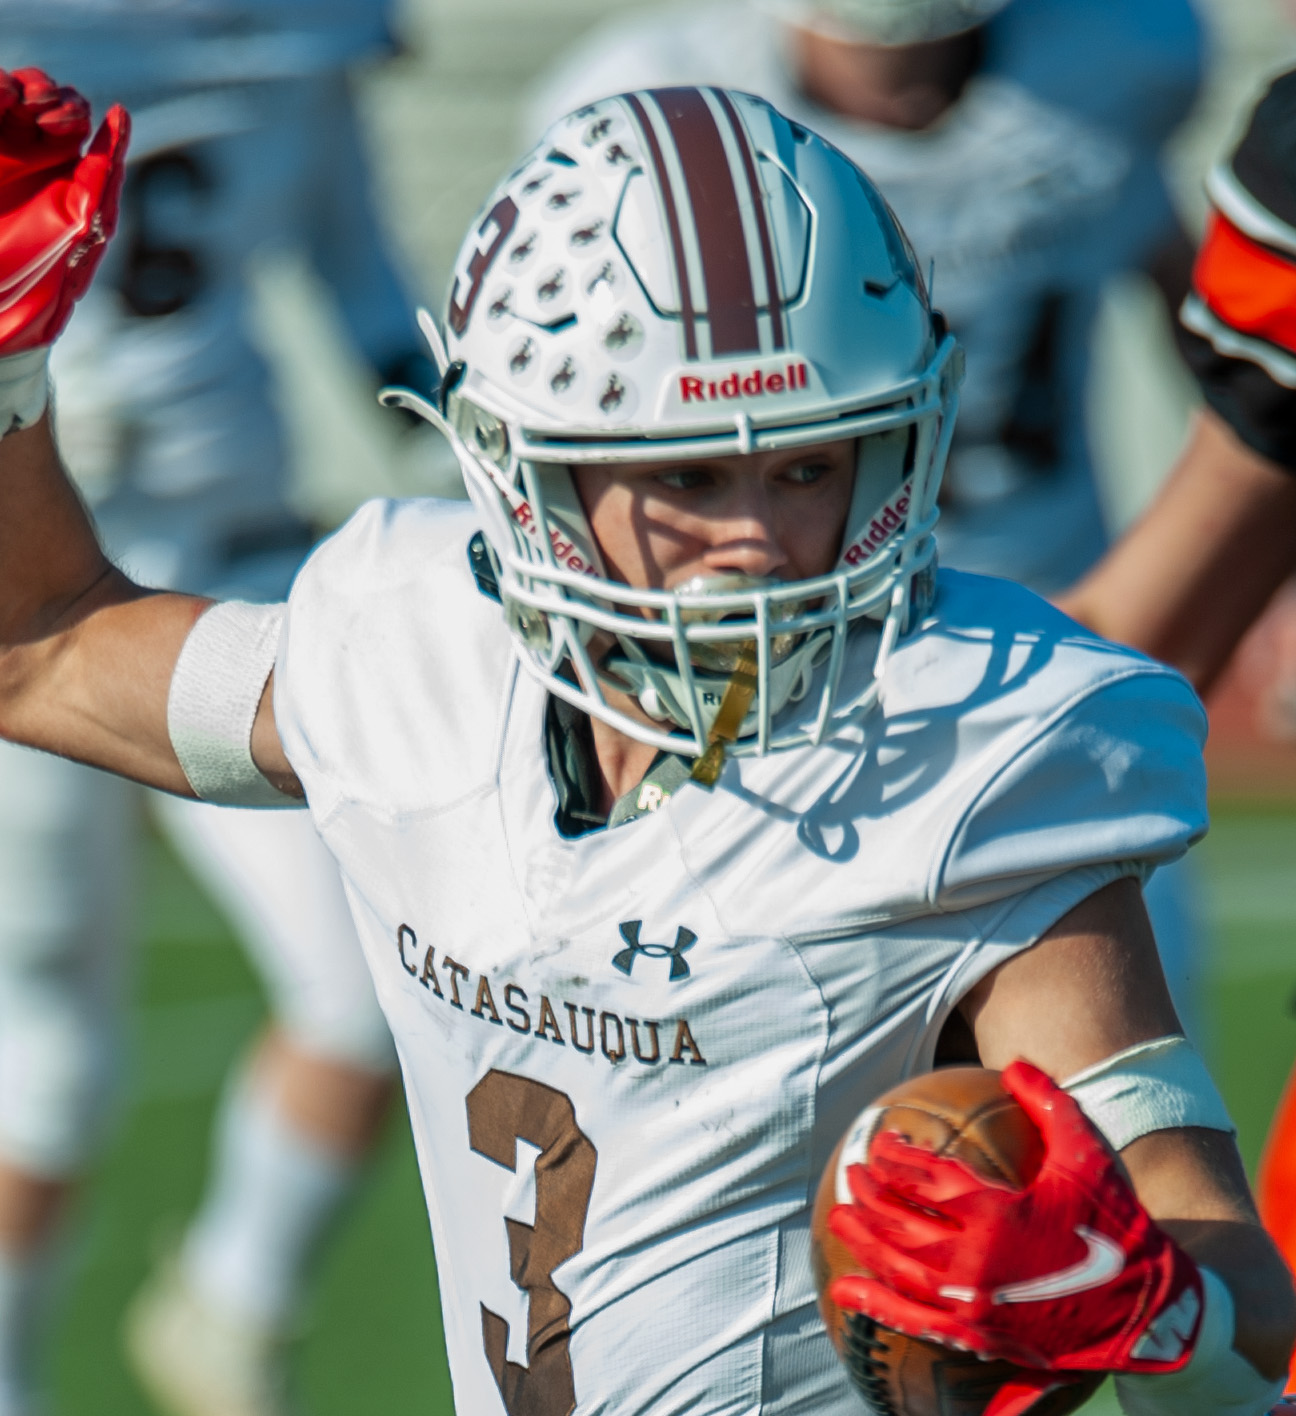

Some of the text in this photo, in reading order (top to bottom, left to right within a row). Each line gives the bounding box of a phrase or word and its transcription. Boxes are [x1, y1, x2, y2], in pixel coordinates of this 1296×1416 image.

[449, 195, 520, 339] 3
[679, 363, 809, 403] Riddell
[844, 481, 912, 567] Ridde
[397, 923, 708, 1066] CATASAUQUA
